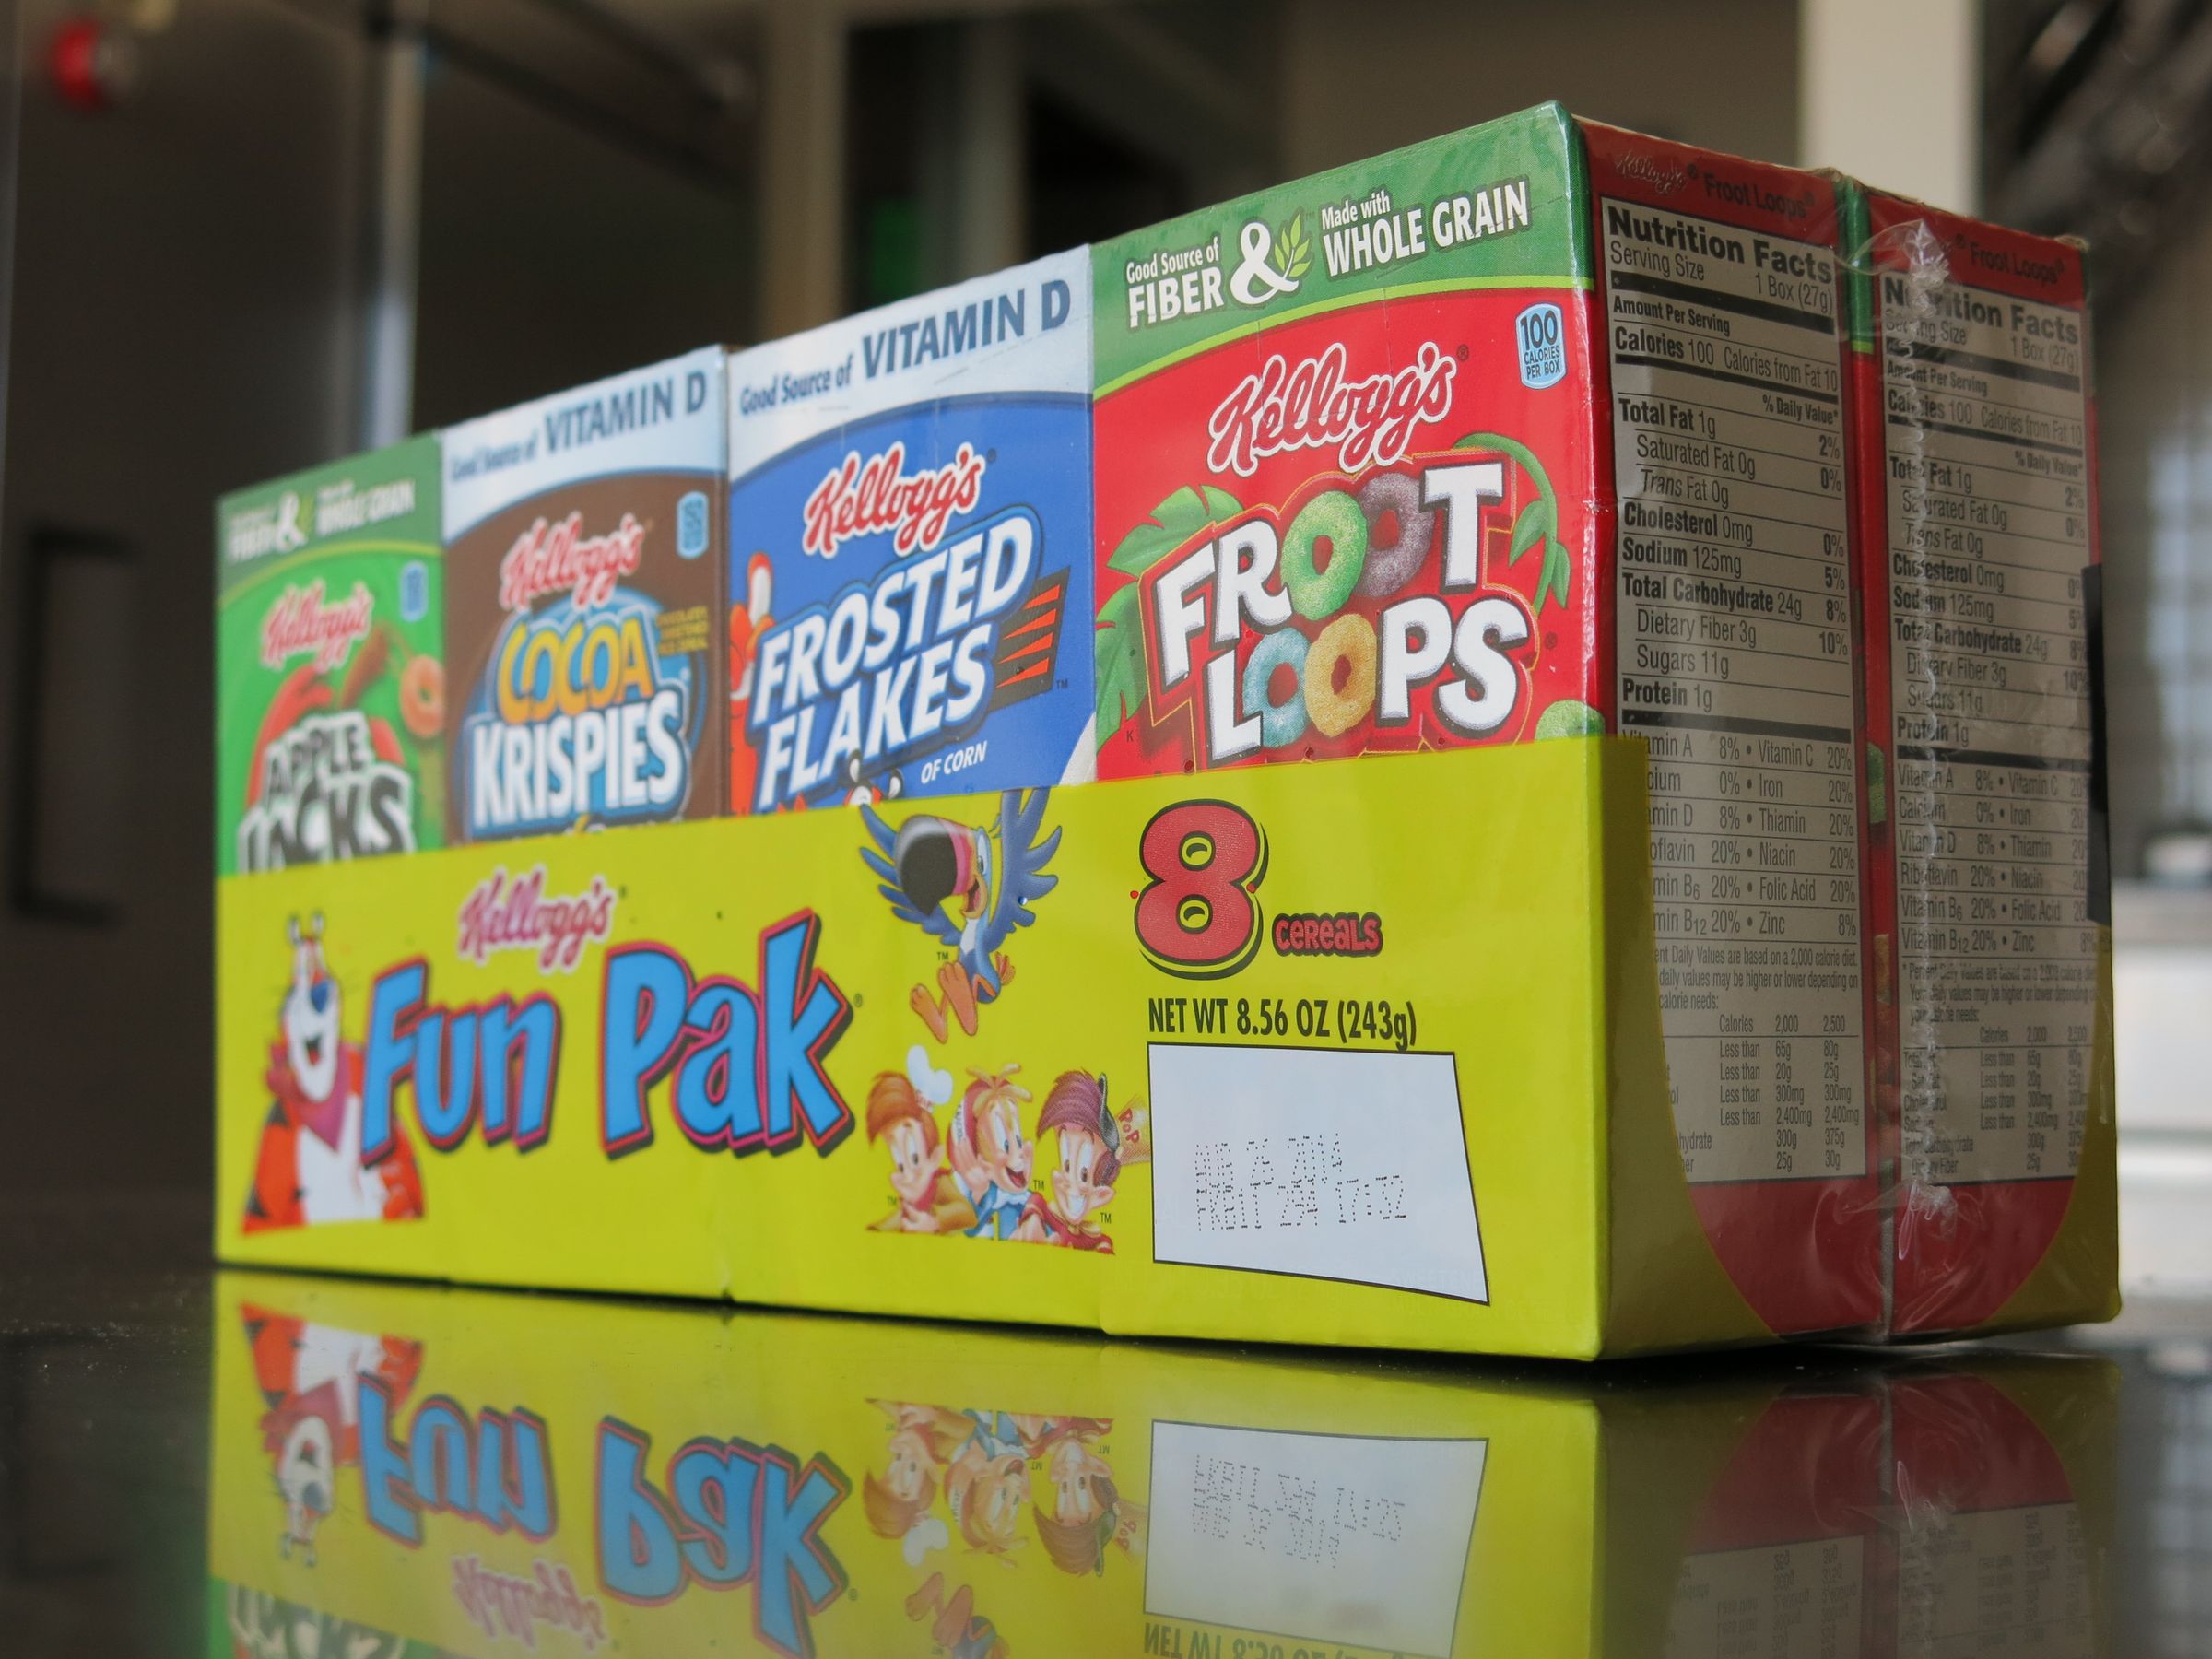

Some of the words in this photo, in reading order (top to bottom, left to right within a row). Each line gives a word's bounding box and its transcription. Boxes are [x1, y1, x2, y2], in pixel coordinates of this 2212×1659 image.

[1320, 205, 1359, 231] Made
[1360, 191, 1391, 217] with
[1704, 173, 1750, 207] Froot
[1322, 208, 1426, 277] WHOLE
[1432, 181, 1529, 249] GRAIN
[1608, 206, 1745, 264] Nutrition
[1754, 239, 1832, 284] Facts
[1125, 261, 1159, 283] Good
[1160, 247, 1205, 276] Source
[1206, 236, 1220, 264] of
[1611, 241, 1670, 276] Serving
[1676, 253, 1704, 281] Size
[1755, 273, 1762, 294] 1
[1769, 276, 1794, 302] Box
[1798, 280, 1832, 315] (27g)
[1128, 266, 1225, 329] FIBER
[1614, 296, 1663, 319] Amount
[1666, 303, 1685, 324] Per
[1688, 310, 1730, 336] Serving
[740, 375, 777, 415] Good
[781, 369, 830, 403] Source
[836, 353, 852, 387] of
[863, 288, 1026, 379] VITAMIN
[1041, 279, 1070, 331] D
[1520, 311, 1558, 350] 100
[1941, 322, 1967, 345] Size
[2010, 304, 2078, 344] Facts
[1524, 346, 1560, 365] CALORIES
[1527, 364, 1541, 380] PER
[1545, 359, 1560, 375] BOX
[1615, 326, 1684, 359] Calories
[1688, 339, 1714, 365] 100
[1724, 347, 1771, 377] Calories
[1774, 358, 1800, 384] from
[1805, 363, 1821, 386] Fat
[1825, 370, 1838, 392] 10
[545, 377, 674, 453] VITAMIN
[687, 371, 706, 414] D
[1206, 341, 1457, 477] Kellogg's
[1618, 398, 1665, 424] Total
[1670, 405, 1694, 430] Fat
[1699, 411, 1715, 440] 1g
[1819, 435, 1840, 459] 2%
[1763, 394, 1774, 412] %
[1777, 398, 1802, 422] Daily
[1637, 434, 1708, 467] Saturated
[1713, 447, 1735, 473] Fat
[1738, 453, 1755, 480] 0g
[1821, 468, 1841, 492] 0%
[1930, 464, 1952, 487] Fat
[1958, 469, 1971, 495] 1g
[803, 441, 985, 559] Kellogg's
[1641, 468, 1682, 497] Trans
[1687, 476, 1708, 500] Fat
[1712, 480, 1729, 509] 0g
[1624, 501, 1718, 537] Cholesterol
[1723, 512, 1753, 547] 0mg
[1823, 534, 1843, 557] 0%
[498, 510, 644, 616] Kellogg's
[1152, 463, 1503, 695] FROOT
[1623, 537, 1688, 567] Sodium
[1695, 547, 1741, 579] 125mg
[1825, 567, 1844, 590] 5%
[1622, 572, 1666, 599] Total
[1673, 577, 1773, 613] Carbohydrate
[1778, 592, 1802, 620] 24g
[1827, 599, 1846, 622] 8%
[260, 577, 374, 675] Kellogg's
[752, 516, 1033, 727] FROSTED
[1638, 609, 1695, 641] Dietary
[1700, 615, 1735, 642] Fiber
[1739, 620, 1756, 649] 3g
[1819, 632, 1848, 656] 10%
[1936, 623, 2021, 653] Carbohydrate
[497, 618, 654, 724] COCOA
[1205, 596, 1529, 767] LOOPS
[1637, 644, 1696, 675] Sugars
[1702, 650, 1729, 679] 11g
[1957, 658, 1988, 681] Fiber
[1991, 663, 2006, 687] 3g
[758, 624, 992, 810] FLAKES
[1622, 678, 1688, 705] Protein
[1694, 684, 1712, 712] 1g
[473, 690, 682, 828] KRISPIES
[921, 760, 940, 785] OF
[943, 741, 988, 772] CORN
[1683, 734, 1693, 757] A
[1719, 737, 1740, 760] 8%
[1759, 739, 1802, 766] Vitamin
[1806, 744, 1813, 767] C
[1828, 747, 1852, 771] 20%
[1720, 771, 1740, 794] 0%
[1759, 774, 1783, 798] Iron
[1829, 781, 1853, 804] 20%
[1684, 804, 1693, 826] D
[1720, 806, 1740, 830] 8%
[1759, 808, 1806, 833] Thiamin
[1830, 814, 1853, 837] 20%
[1712, 841, 1741, 864] 20%
[1759, 842, 1796, 866] Niacin
[1830, 847, 1854, 870] 20%
[1134, 798, 1269, 981] 8
[1712, 876, 1741, 899] 20%
[1759, 877, 1787, 900] Folic
[1790, 879, 1817, 901] Acid
[1830, 880, 1855, 903] 20%
[457, 865, 618, 973] Kellogg's
[1712, 911, 1741, 933] 20%
[1759, 911, 1784, 934] Zinc
[1839, 913, 1856, 936] 8%
[2012, 930, 2035, 952] Zinc
[361, 955, 562, 1167] Fun
[601, 908, 853, 1160] Pak
[1148, 998, 1187, 1034] NET
[1194, 998, 1228, 1033] WT
[1237, 998, 1288, 1036] 8.56
[1296, 1000, 1331, 1037] OZ
[1337, 1000, 1417, 1051] (243g)
[1720, 1014, 1753, 1032] Calories
[1775, 1015, 1798, 1033] 2,000
[1720, 1041, 1740, 1057] Less
[1743, 1041, 1760, 1057] than
